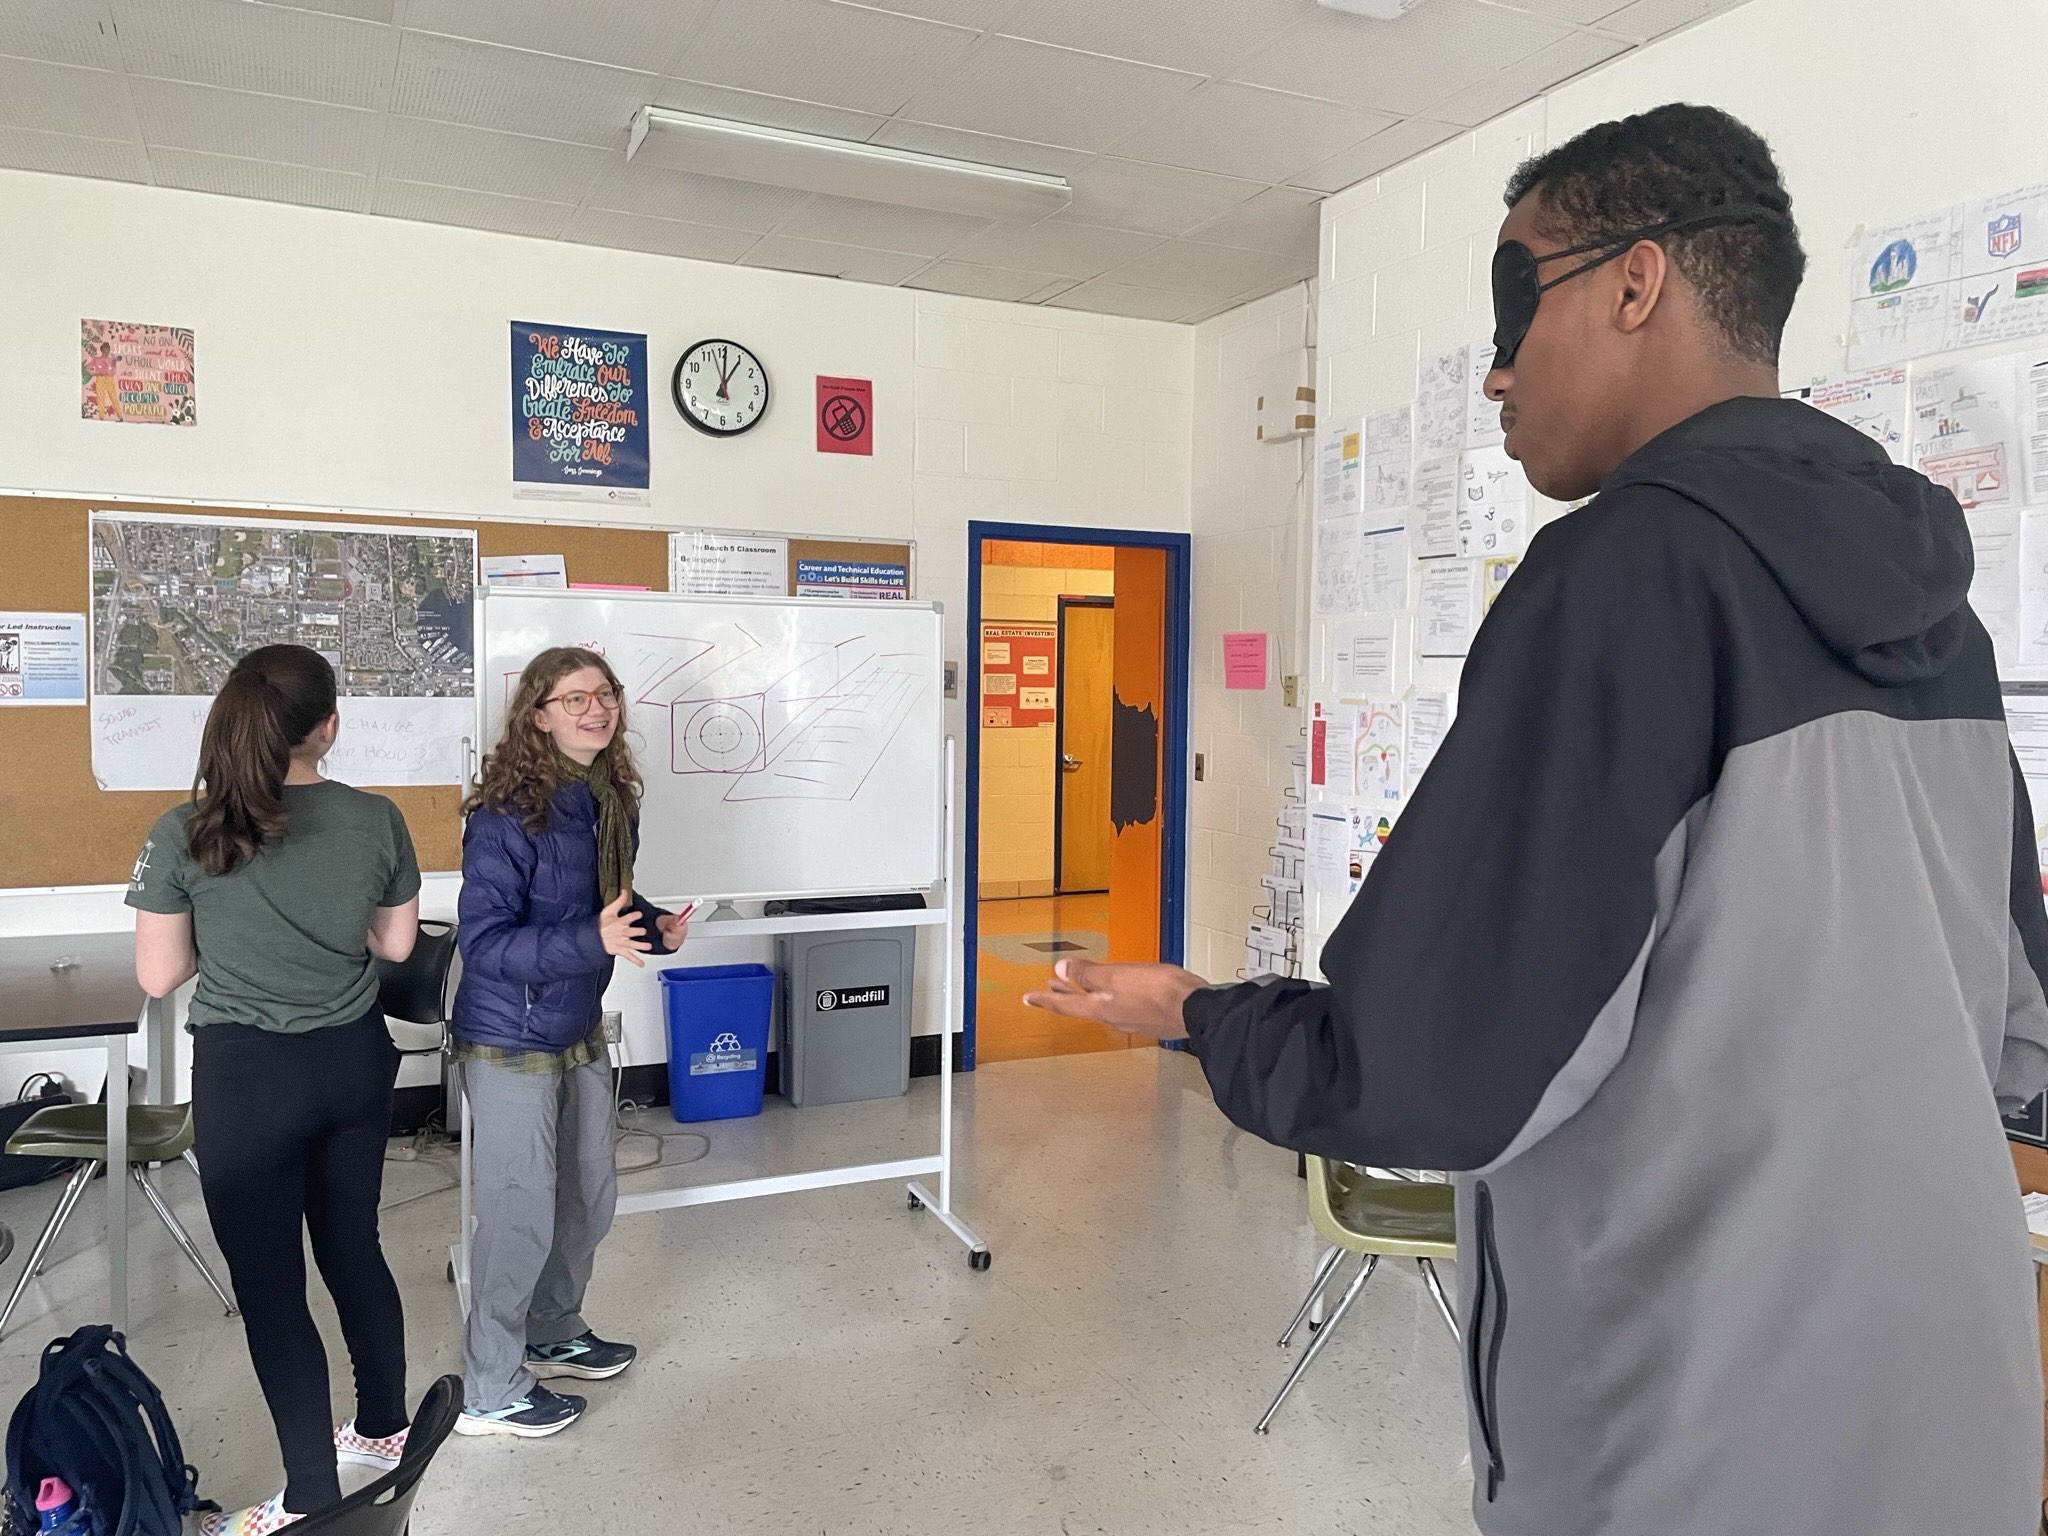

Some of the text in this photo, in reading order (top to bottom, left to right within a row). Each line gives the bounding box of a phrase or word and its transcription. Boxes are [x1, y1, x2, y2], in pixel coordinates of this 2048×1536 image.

[1990, 231, 2018, 254] NFL
[143, 336, 156, 346] NO
[158, 337, 174, 347] ONE
[112, 344, 142, 356] SPEAKS
[165, 348, 178, 358] the
[528, 332, 630, 366] We Have To
[125, 356, 185, 370] WHOLE WORLD
[702, 351, 710, 362] 11
[531, 354, 630, 386] Embrace Our
[690, 362, 700, 373] 10
[748, 368, 754, 378] 2
[134, 370, 161, 380] SILENT
[166, 372, 188, 382] THEN
[120, 380, 186, 394] EVEN ONE VOICE
[525, 374, 633, 403] Differences To
[685, 378, 692, 389] 9
[754, 385, 759, 396] 3
[120, 393, 159, 404] BECOMES
[1915, 384, 1939, 400] PAST
[691, 396, 697, 406] 8
[748, 401, 754, 412] 4
[124, 404, 166, 416] POWERFUL
[522, 394, 638, 426] Create Freedom
[704, 409, 709, 420] 7
[720, 415, 726, 426] 6
[736, 412, 742, 423] 5
[528, 417, 626, 446] & Acceptance
[550, 439, 612, 466] For All
[1914, 440, 1953, 456] FUTURE
[838, 566, 869, 574] Technical
[99, 706, 136, 730] SOUND
[104, 718, 162, 746] TRANSIT
[346, 718, 414, 733] CHANGE
[841, 989, 885, 1005] Landfill
